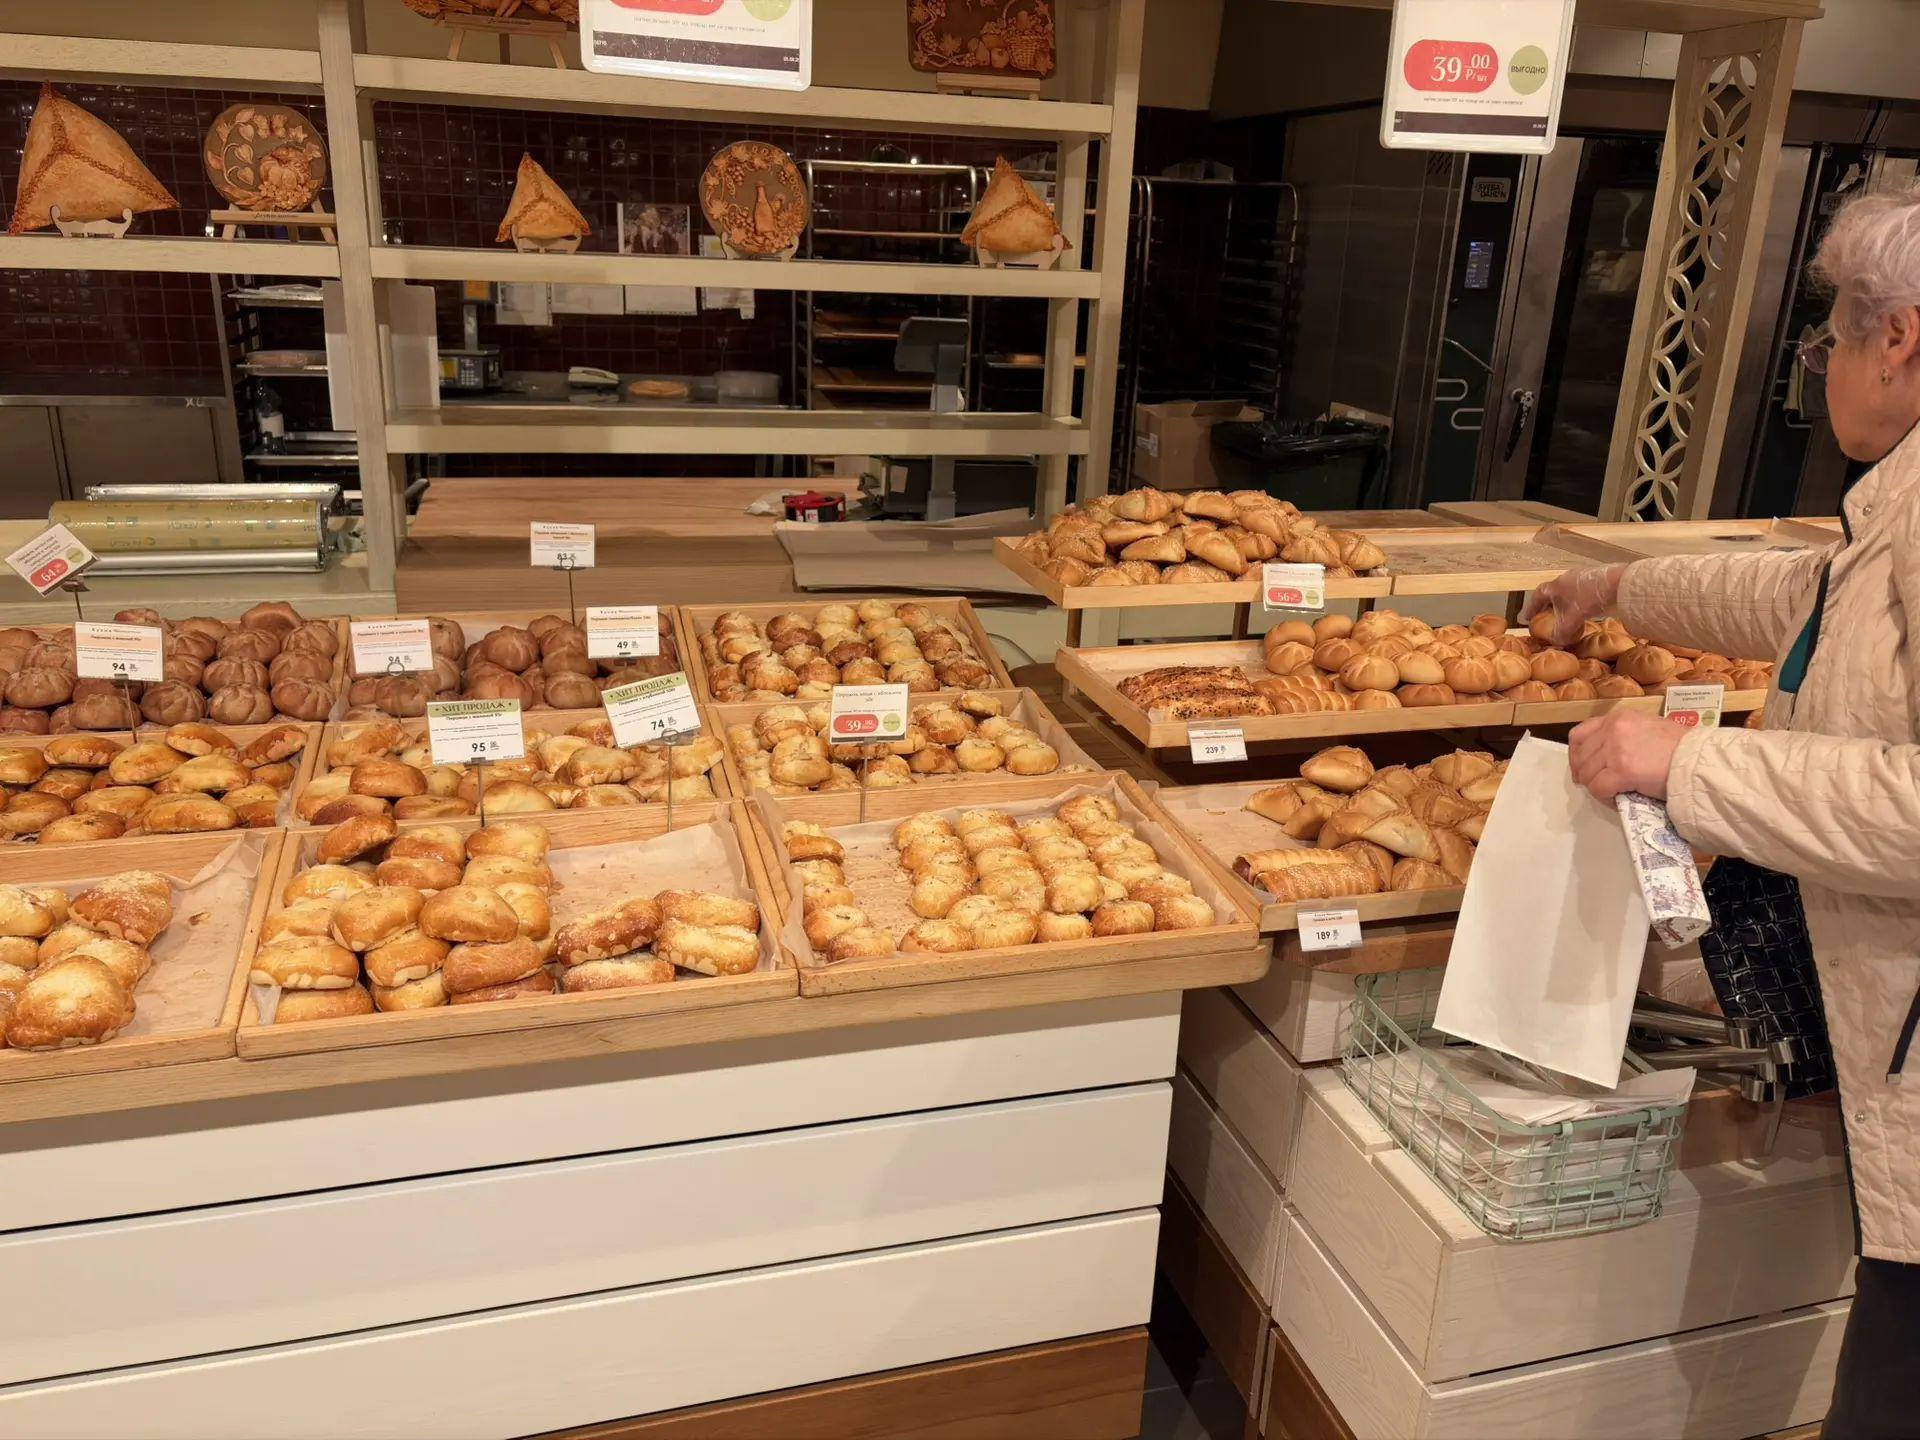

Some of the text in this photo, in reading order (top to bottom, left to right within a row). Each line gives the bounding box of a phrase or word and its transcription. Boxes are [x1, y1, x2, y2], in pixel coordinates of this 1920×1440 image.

[1430, 53, 1491, 83] 39 00
[41, 569, 56, 581] 64
[1277, 592, 1290, 602] 56
[617, 641, 629, 649] 49
[112, 663, 126, 671] 94
[615, 677, 673, 697] ХИТ ПРОДАЖ
[442, 702, 505, 712] ХИТ ПРОДАЖ
[650, 719, 665, 730] 74
[471, 743, 486, 752] 95
[1205, 746, 1219, 754] 239
[1316, 931, 1331, 940] 189
